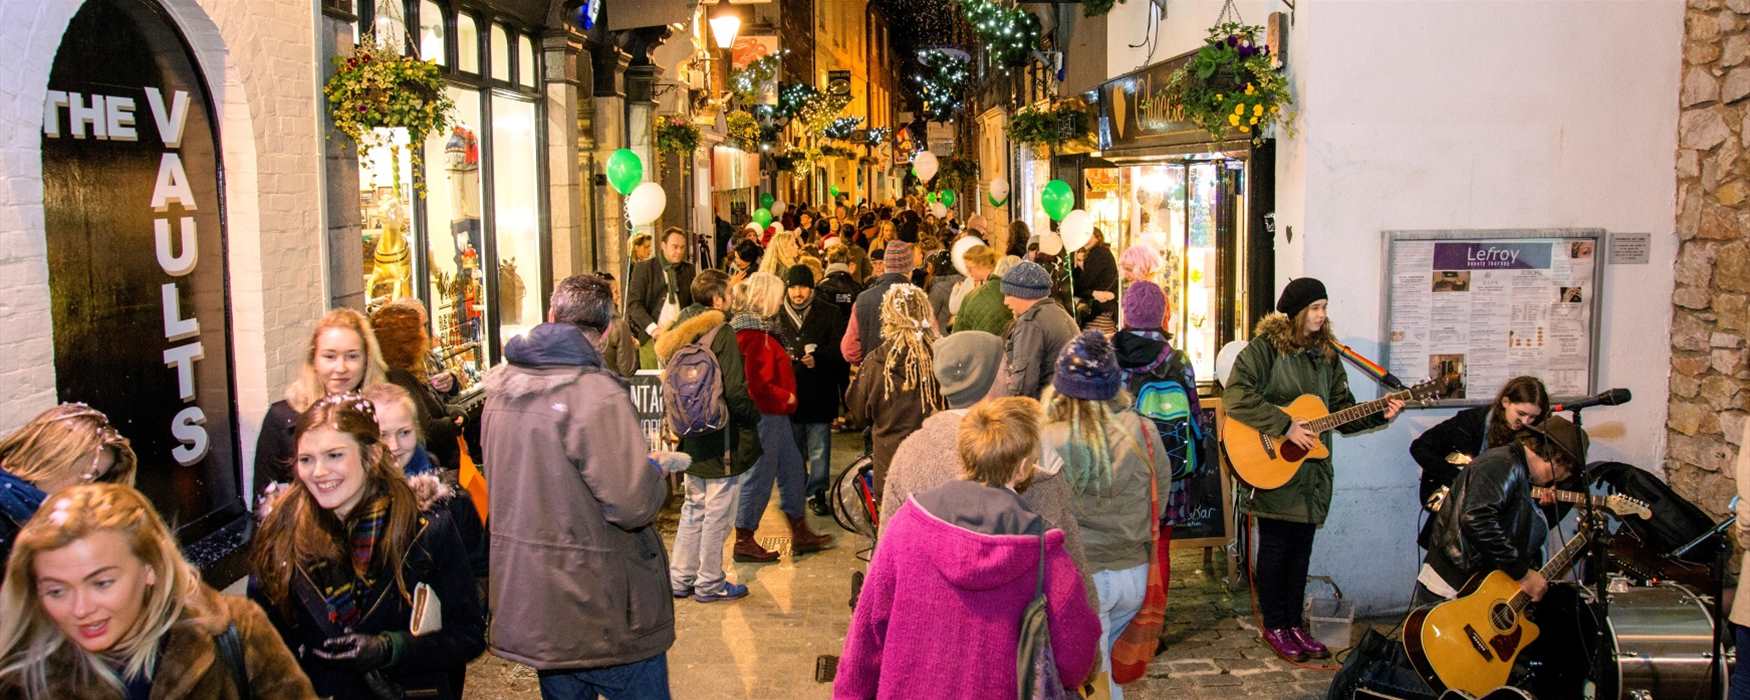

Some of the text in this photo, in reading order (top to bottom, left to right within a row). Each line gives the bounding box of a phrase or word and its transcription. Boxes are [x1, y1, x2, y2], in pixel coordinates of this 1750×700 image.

[44, 90, 138, 141] THE
[144, 86, 209, 467] VAULTS
[1467, 246, 1520, 265] Lefroy
